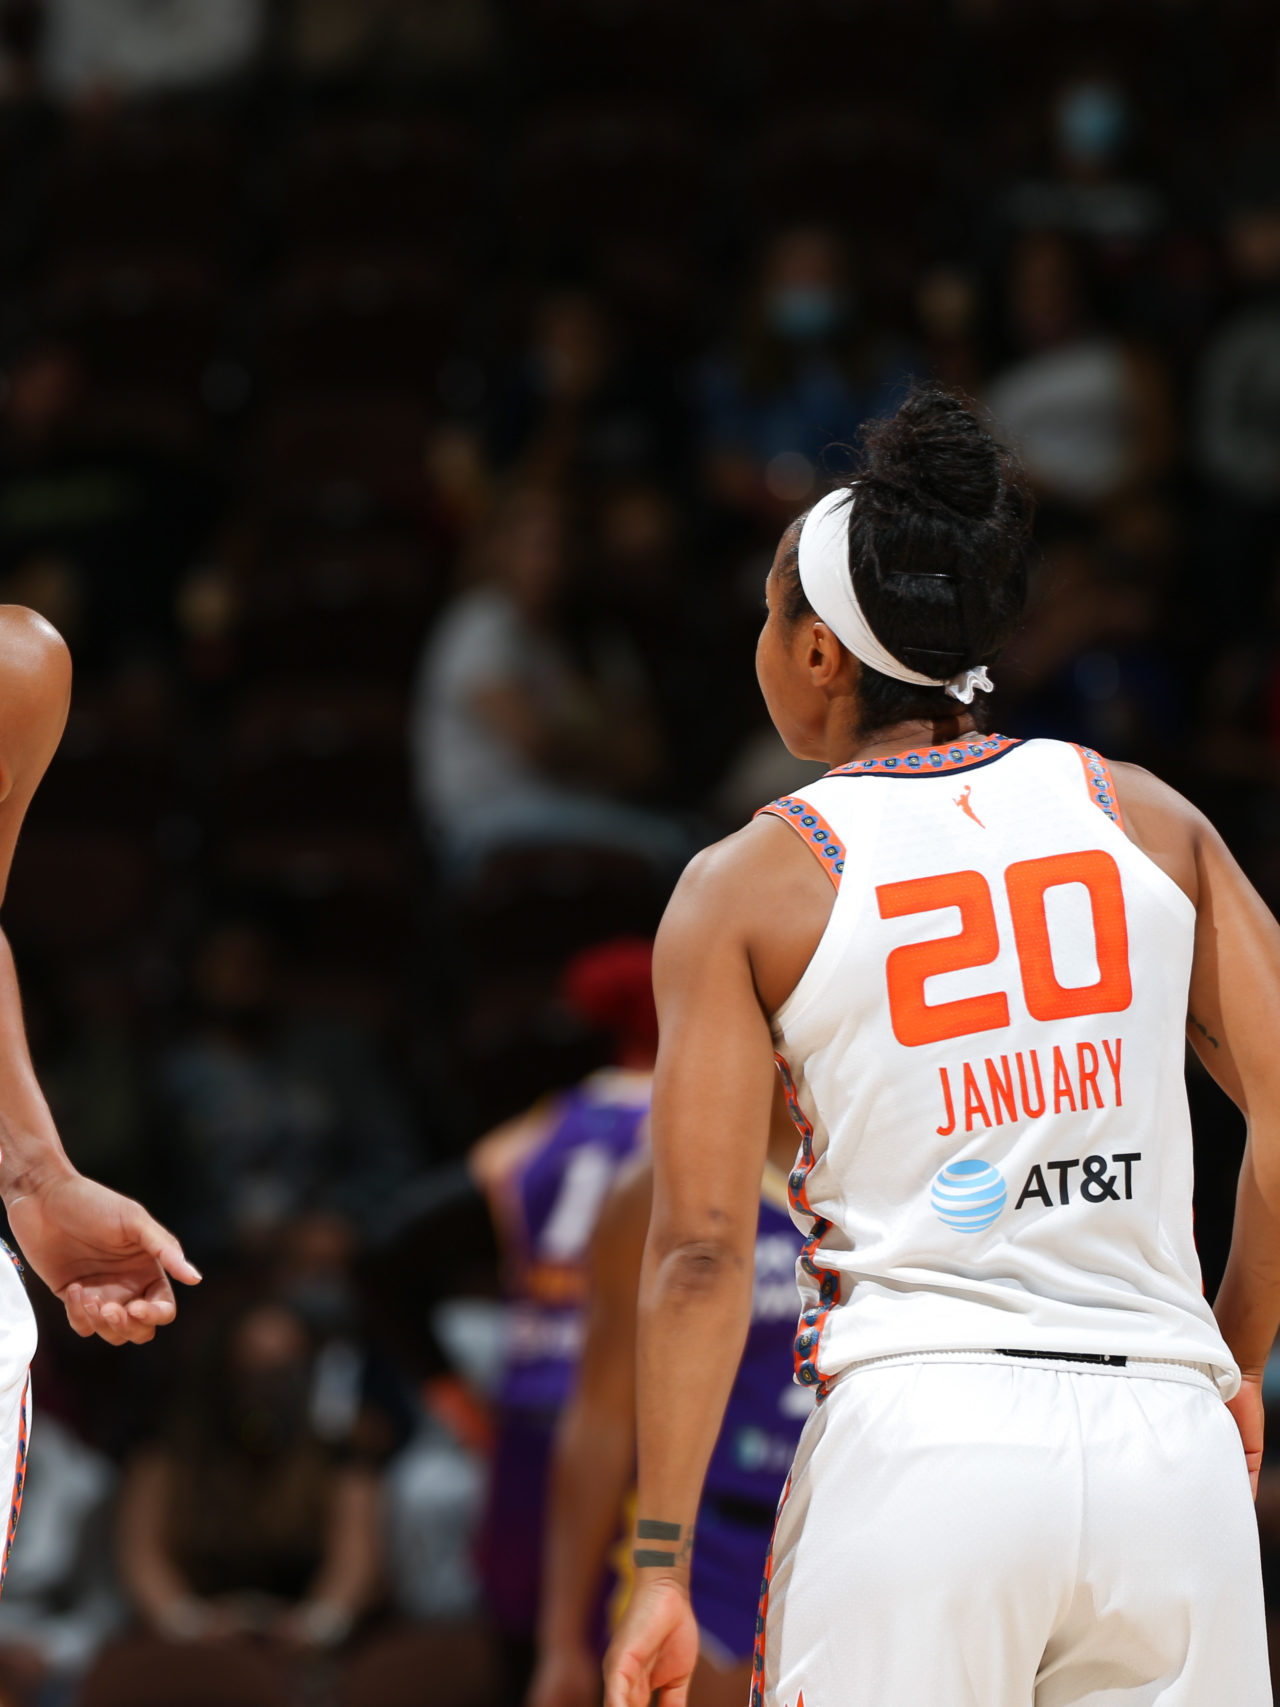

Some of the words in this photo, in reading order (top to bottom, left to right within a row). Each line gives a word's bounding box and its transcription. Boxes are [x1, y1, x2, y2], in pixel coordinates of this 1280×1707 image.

[875, 849, 1133, 1048] 20
[936, 1038, 1123, 1136] JANUARY
[1015, 1152, 1142, 1211] AT&T
